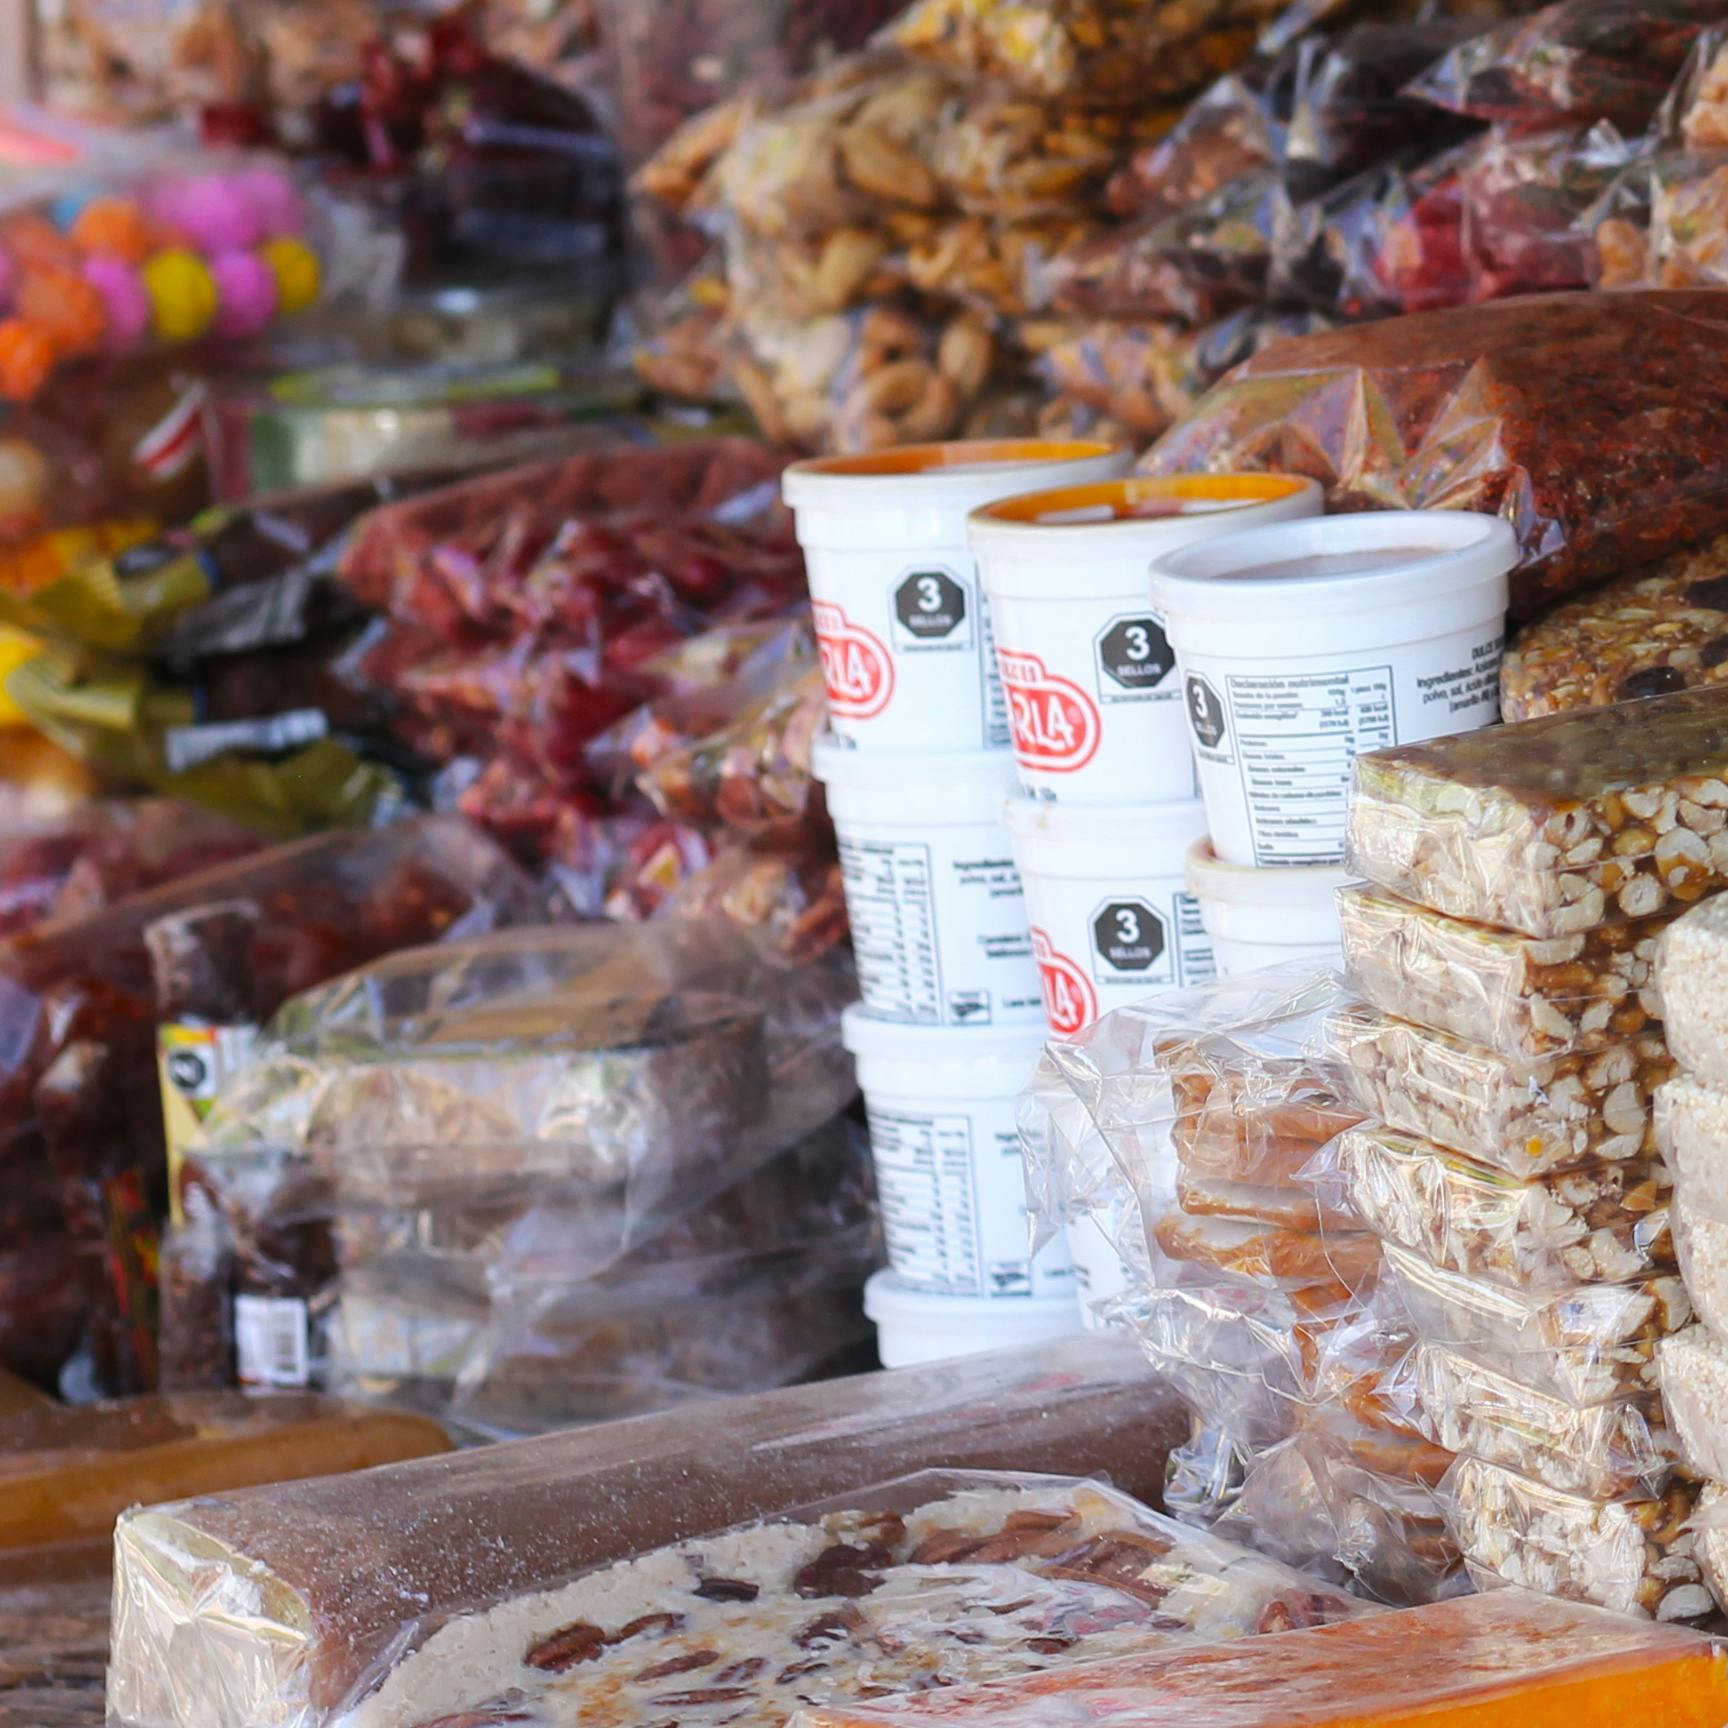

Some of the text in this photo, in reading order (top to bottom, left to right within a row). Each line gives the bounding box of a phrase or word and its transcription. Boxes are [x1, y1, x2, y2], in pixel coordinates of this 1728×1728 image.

[916, 577, 943, 613] 3
[1124, 625, 1151, 661] 3
[1115, 662, 1162, 677] SELLOS
[1191, 684, 1209, 720] 3
[1010, 692, 1077, 752] RLA
[1114, 908, 1141, 945] 3
